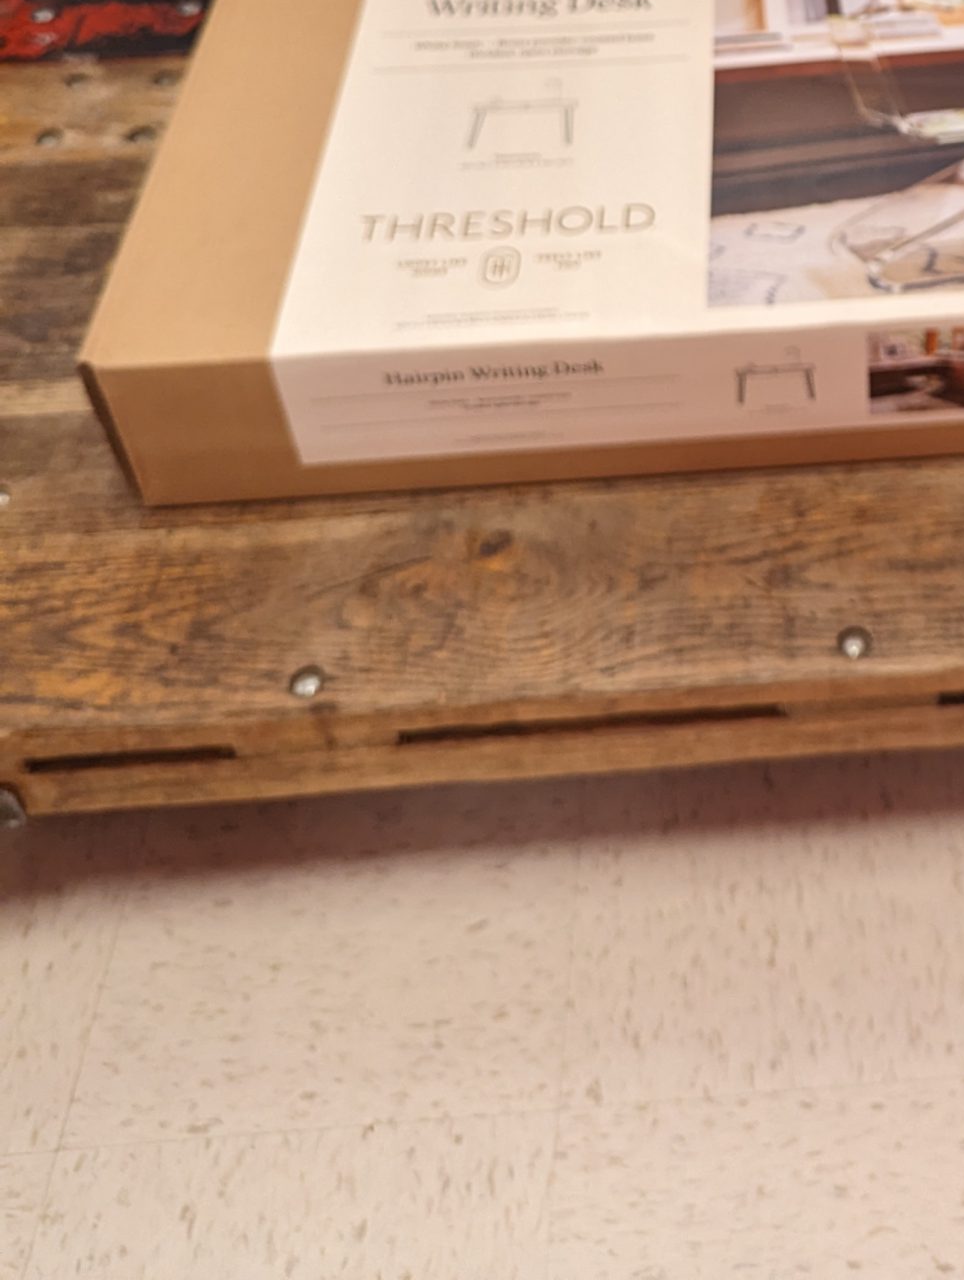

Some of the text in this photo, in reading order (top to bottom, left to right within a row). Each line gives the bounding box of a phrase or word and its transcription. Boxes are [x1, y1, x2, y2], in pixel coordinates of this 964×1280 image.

[360, 201, 657, 244] THRESHOLD
[382, 357, 606, 388] Hairpin Writing Desk
